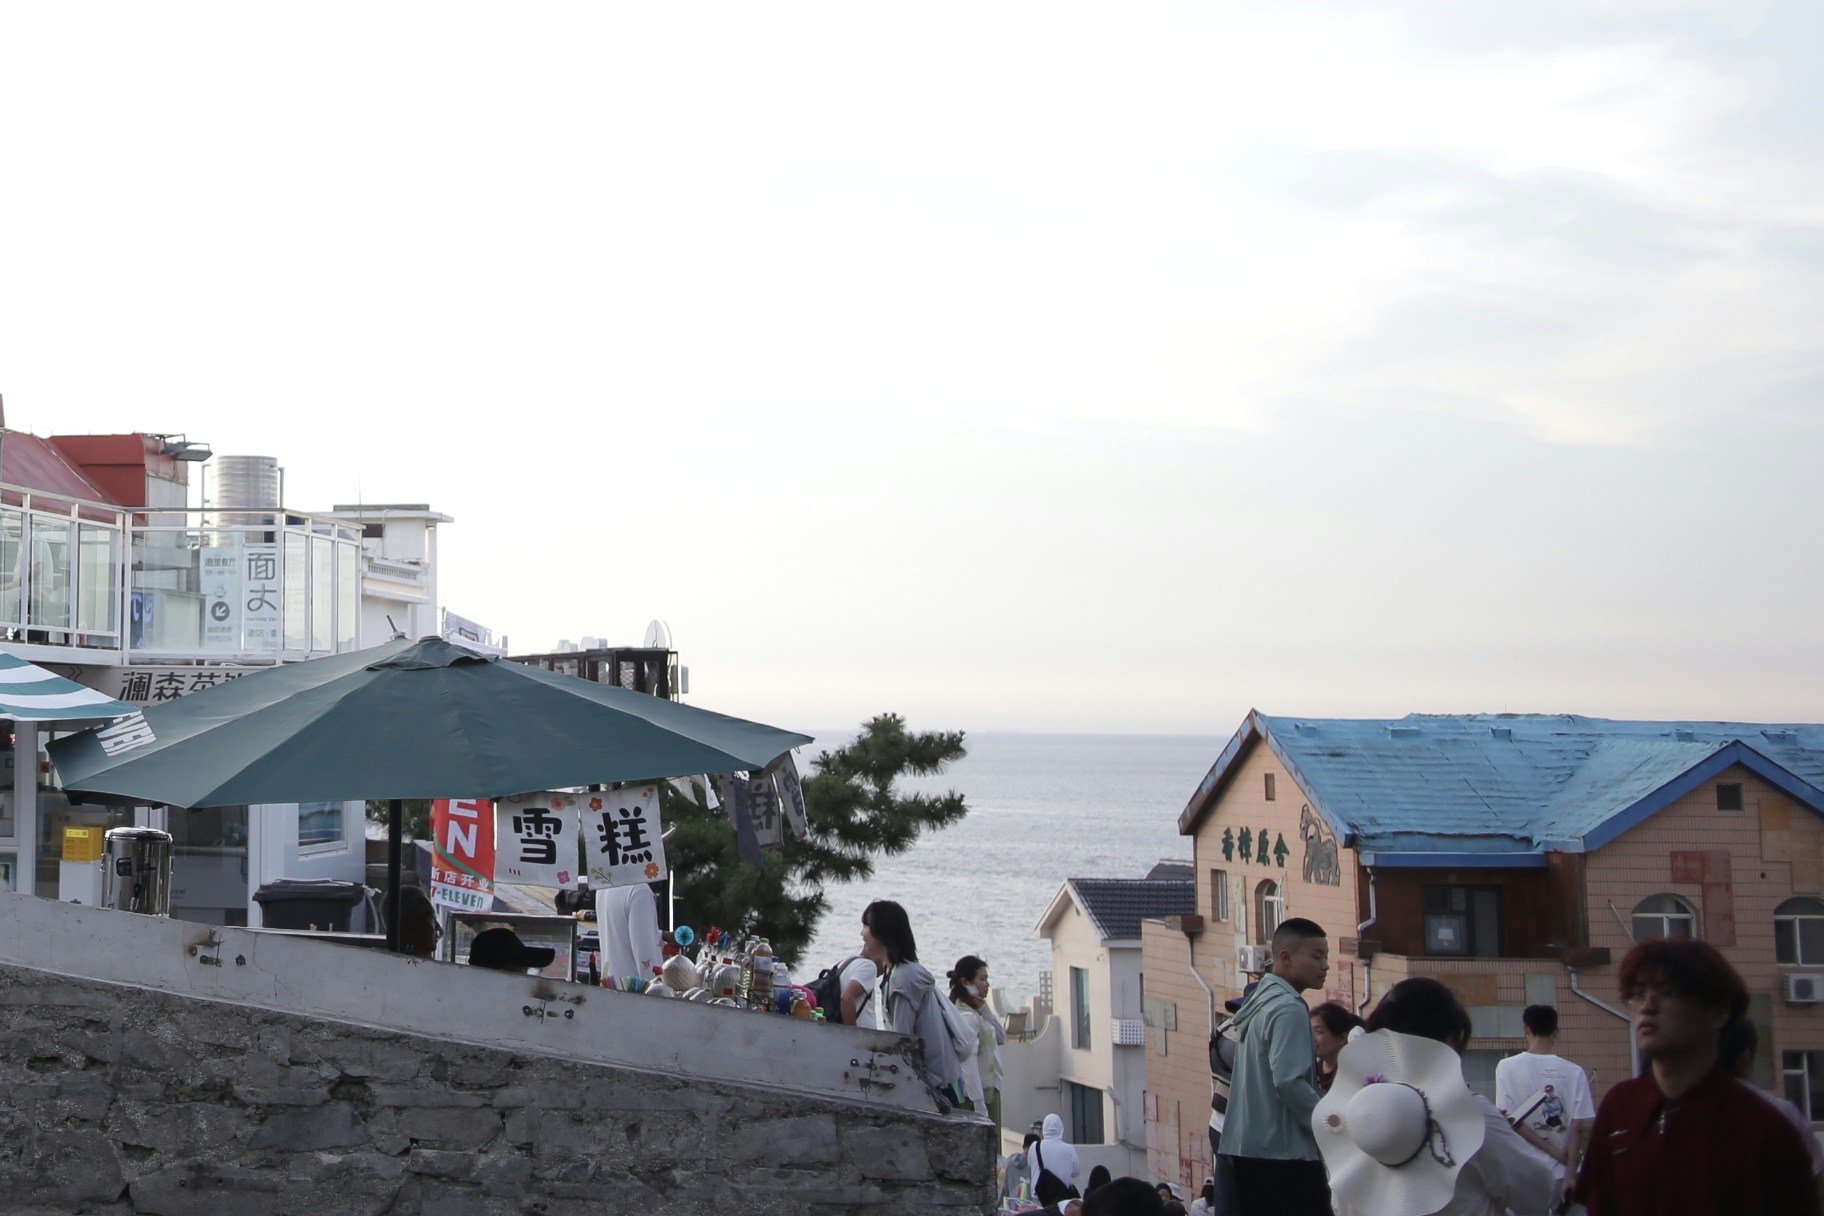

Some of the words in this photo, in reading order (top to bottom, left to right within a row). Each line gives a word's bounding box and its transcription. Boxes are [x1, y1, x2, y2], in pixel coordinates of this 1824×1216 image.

[512, 805, 654, 867] 雪糕
[431, 866, 489, 892] 新店开业
